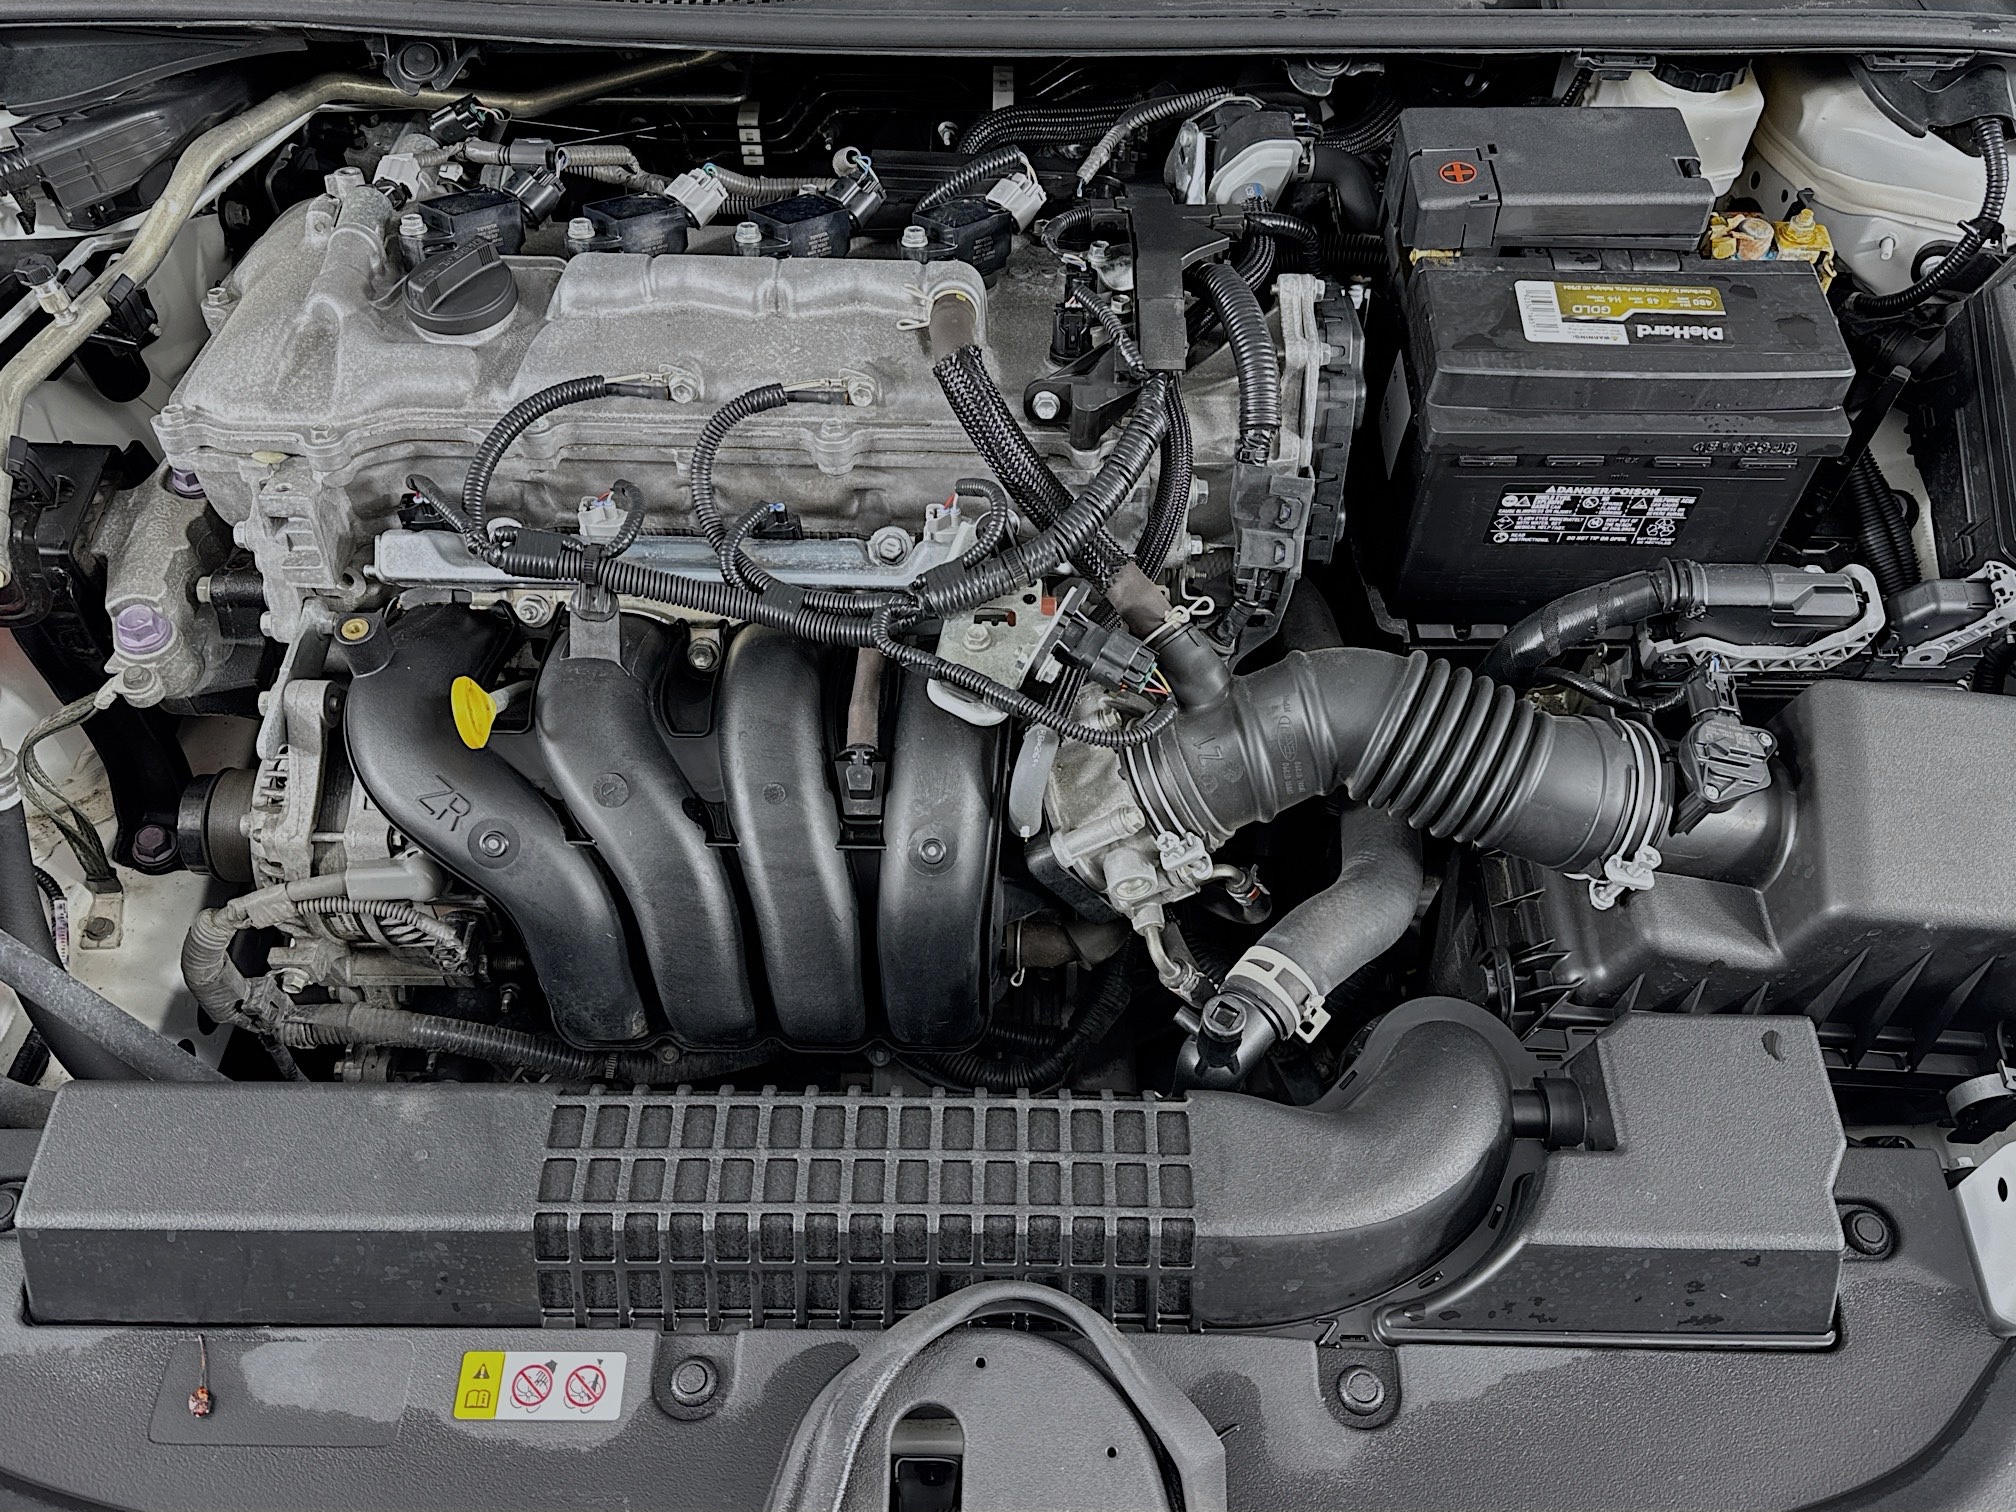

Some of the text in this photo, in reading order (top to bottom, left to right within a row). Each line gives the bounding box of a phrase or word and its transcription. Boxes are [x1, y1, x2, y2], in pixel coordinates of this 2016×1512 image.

[476, 224, 498, 232] TOYOTA
[1572, 305, 1611, 314] GOLD
[1636, 324, 1724, 340] DieHard
[1556, 486, 1661, 496] DANGER/POISON
[415, 774, 472, 832] ZR
